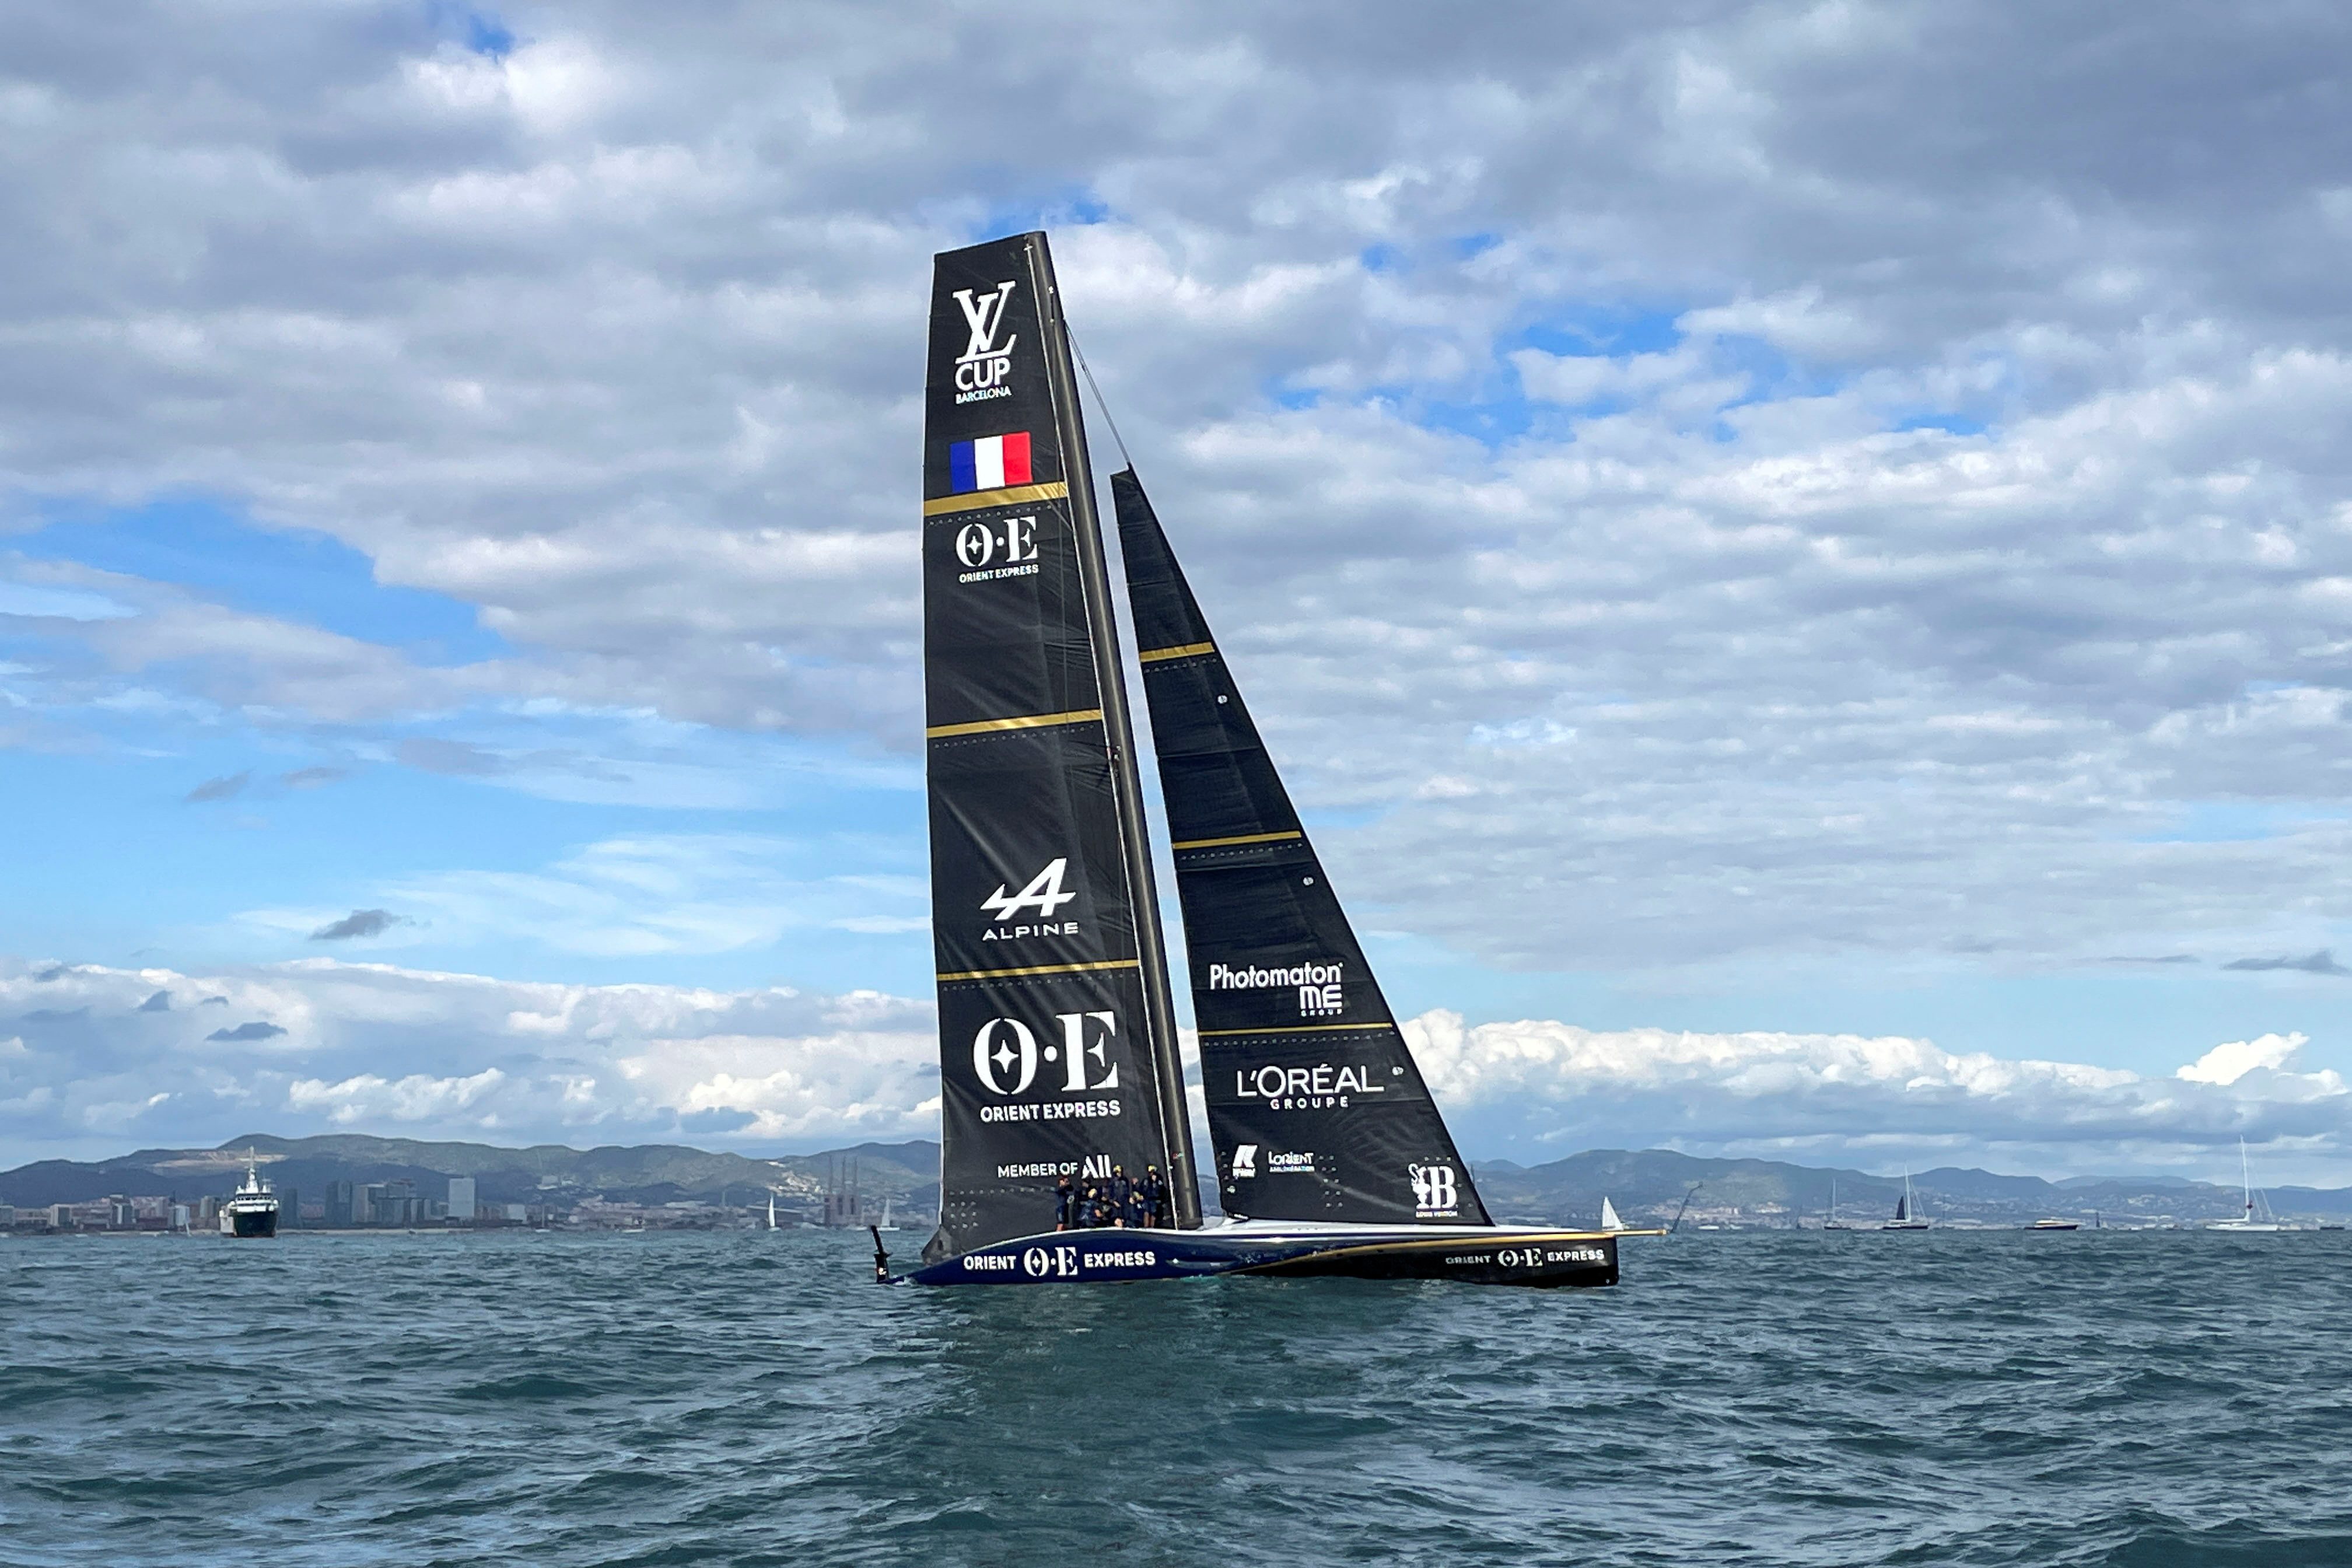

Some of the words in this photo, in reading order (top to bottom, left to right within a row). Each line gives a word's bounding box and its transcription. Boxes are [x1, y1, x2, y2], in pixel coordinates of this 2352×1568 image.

[956, 357, 1011, 391] CUP
[956, 386, 1012, 404] BARCELONA
[959, 568, 995, 583] ORIENT
[995, 564, 1039, 579] EXPRESS
[983, 922, 1078, 940] ALPINE
[1210, 962, 1343, 989] Photomaton
[1236, 1063, 1385, 1098] L'ORÉAL
[981, 1105, 1039, 1122] ORIENT
[1043, 1100, 1120, 1119] EXPRESS
[1270, 1096, 1349, 1110] GROUPE
[998, 1164, 1056, 1177] MEMBER
[1060, 1163, 1077, 1175] OF
[964, 1255, 1016, 1270] ORIENT
[1084, 1252, 1155, 1267] EXPRESS
[1445, 1255, 1491, 1265] ORIENT
[1548, 1249, 1605, 1262] EXPRESS
